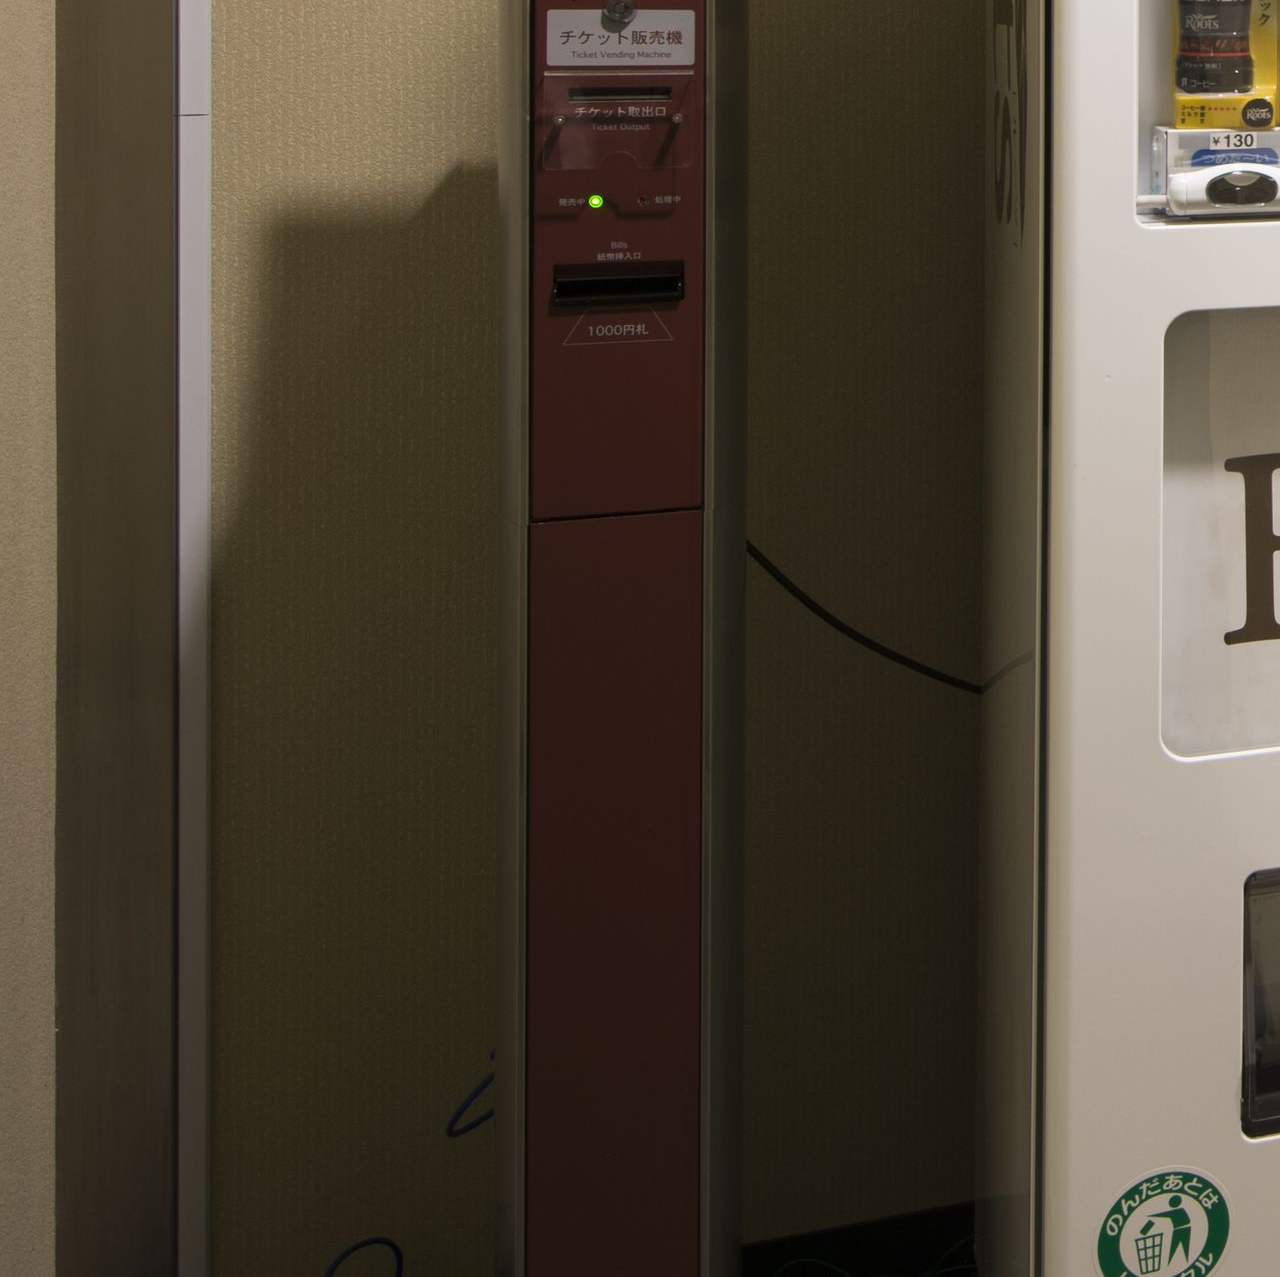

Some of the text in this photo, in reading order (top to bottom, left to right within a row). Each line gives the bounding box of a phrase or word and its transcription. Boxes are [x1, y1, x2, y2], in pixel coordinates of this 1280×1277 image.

[559, 30, 684, 46] チケット販売機
[571, 49, 672, 61] Ticket Vending Machine
[574, 106, 667, 118] チケット取出口
[592, 122, 650, 133] Ticket Output
[610, 241, 628, 250] Bills
[587, 323, 649, 338] 1000円札
[1106, 1173, 1220, 1237] のんだあとは
